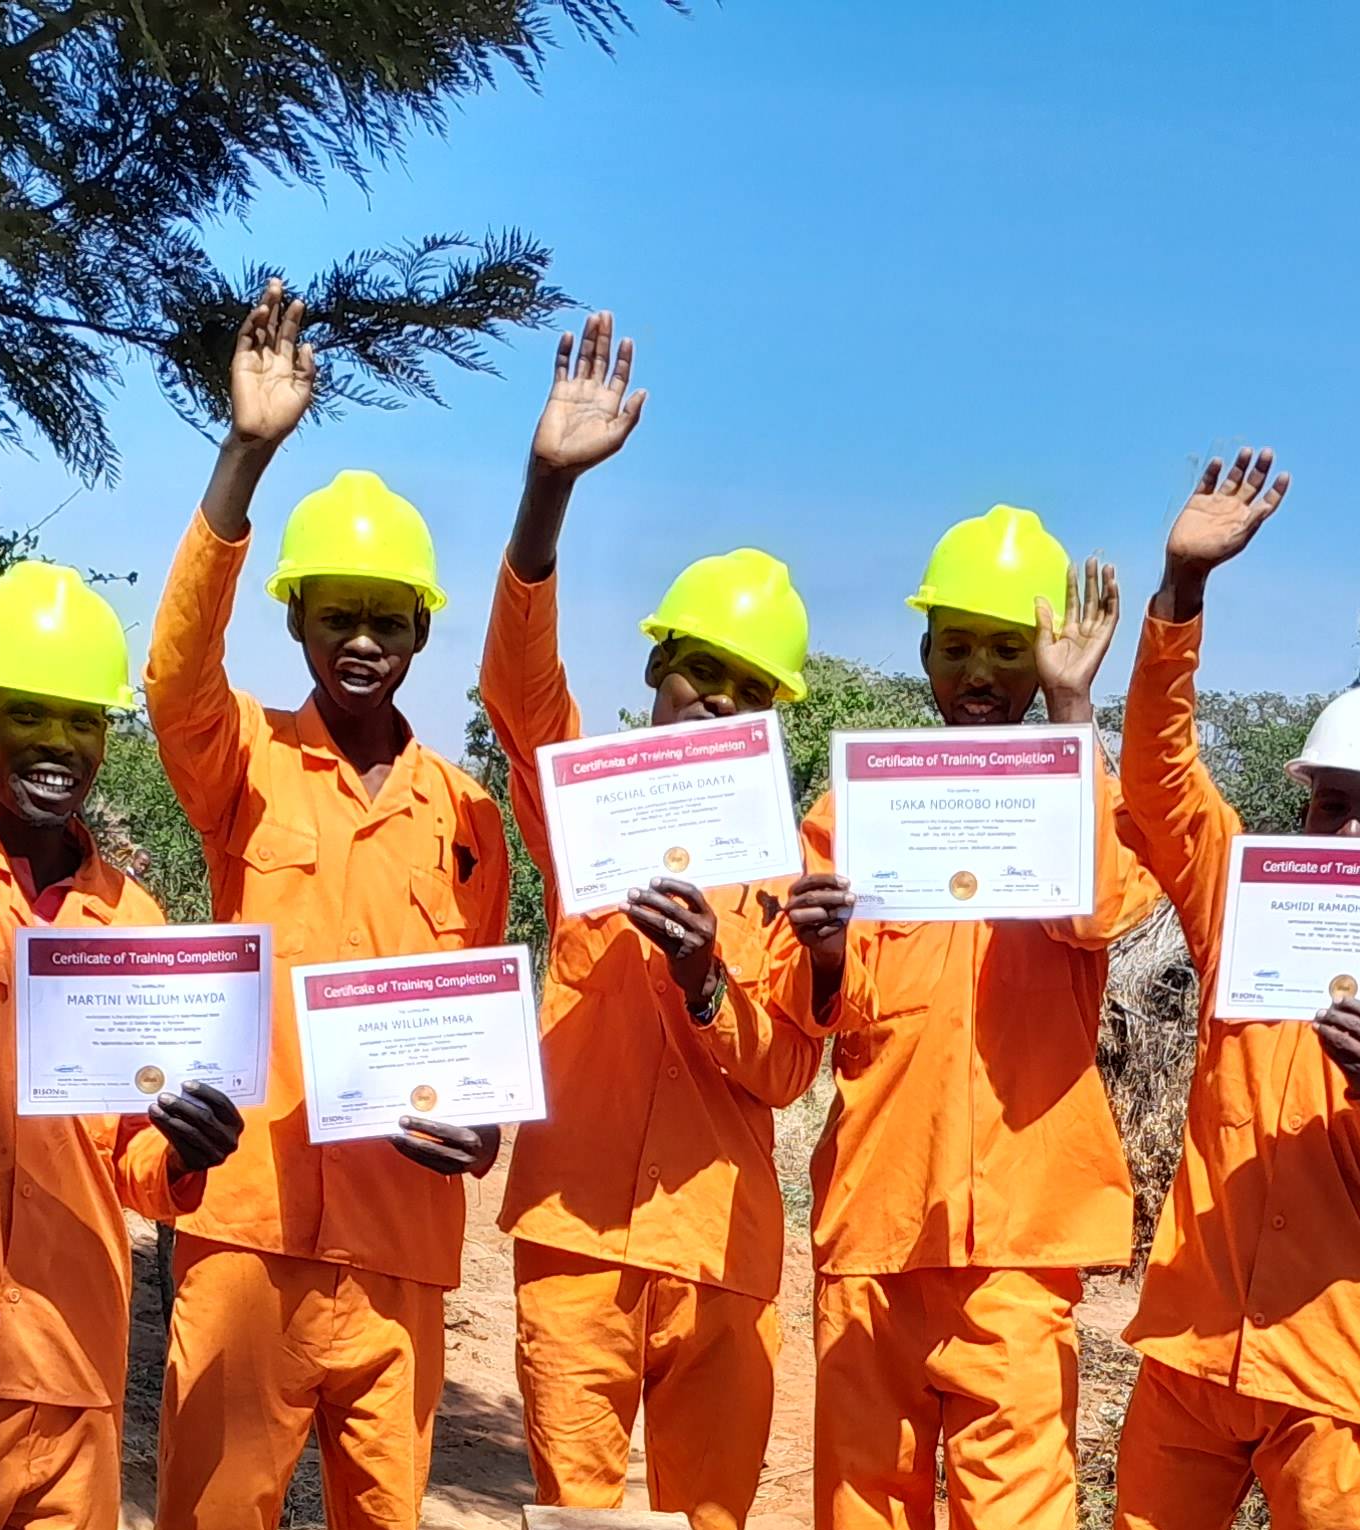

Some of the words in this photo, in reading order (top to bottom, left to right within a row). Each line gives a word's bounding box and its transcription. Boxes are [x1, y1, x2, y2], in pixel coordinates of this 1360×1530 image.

[867, 755, 924, 768] Certificate
[926, 754, 938, 766] of
[941, 753, 986, 768] Training
[989, 752, 1055, 767] Completion
[1263, 861, 1318, 874] Certificate
[1320, 861, 1331, 873] of
[52, 952, 110, 965] Certificate
[113, 952, 126, 964] of
[129, 951, 174, 966] Training
[177, 951, 237, 964] Completion
[324, 984, 375, 998] Certificate
[377, 982, 389, 993] of
[390, 979, 433, 992] Training
[436, 973, 495, 988] Completion
